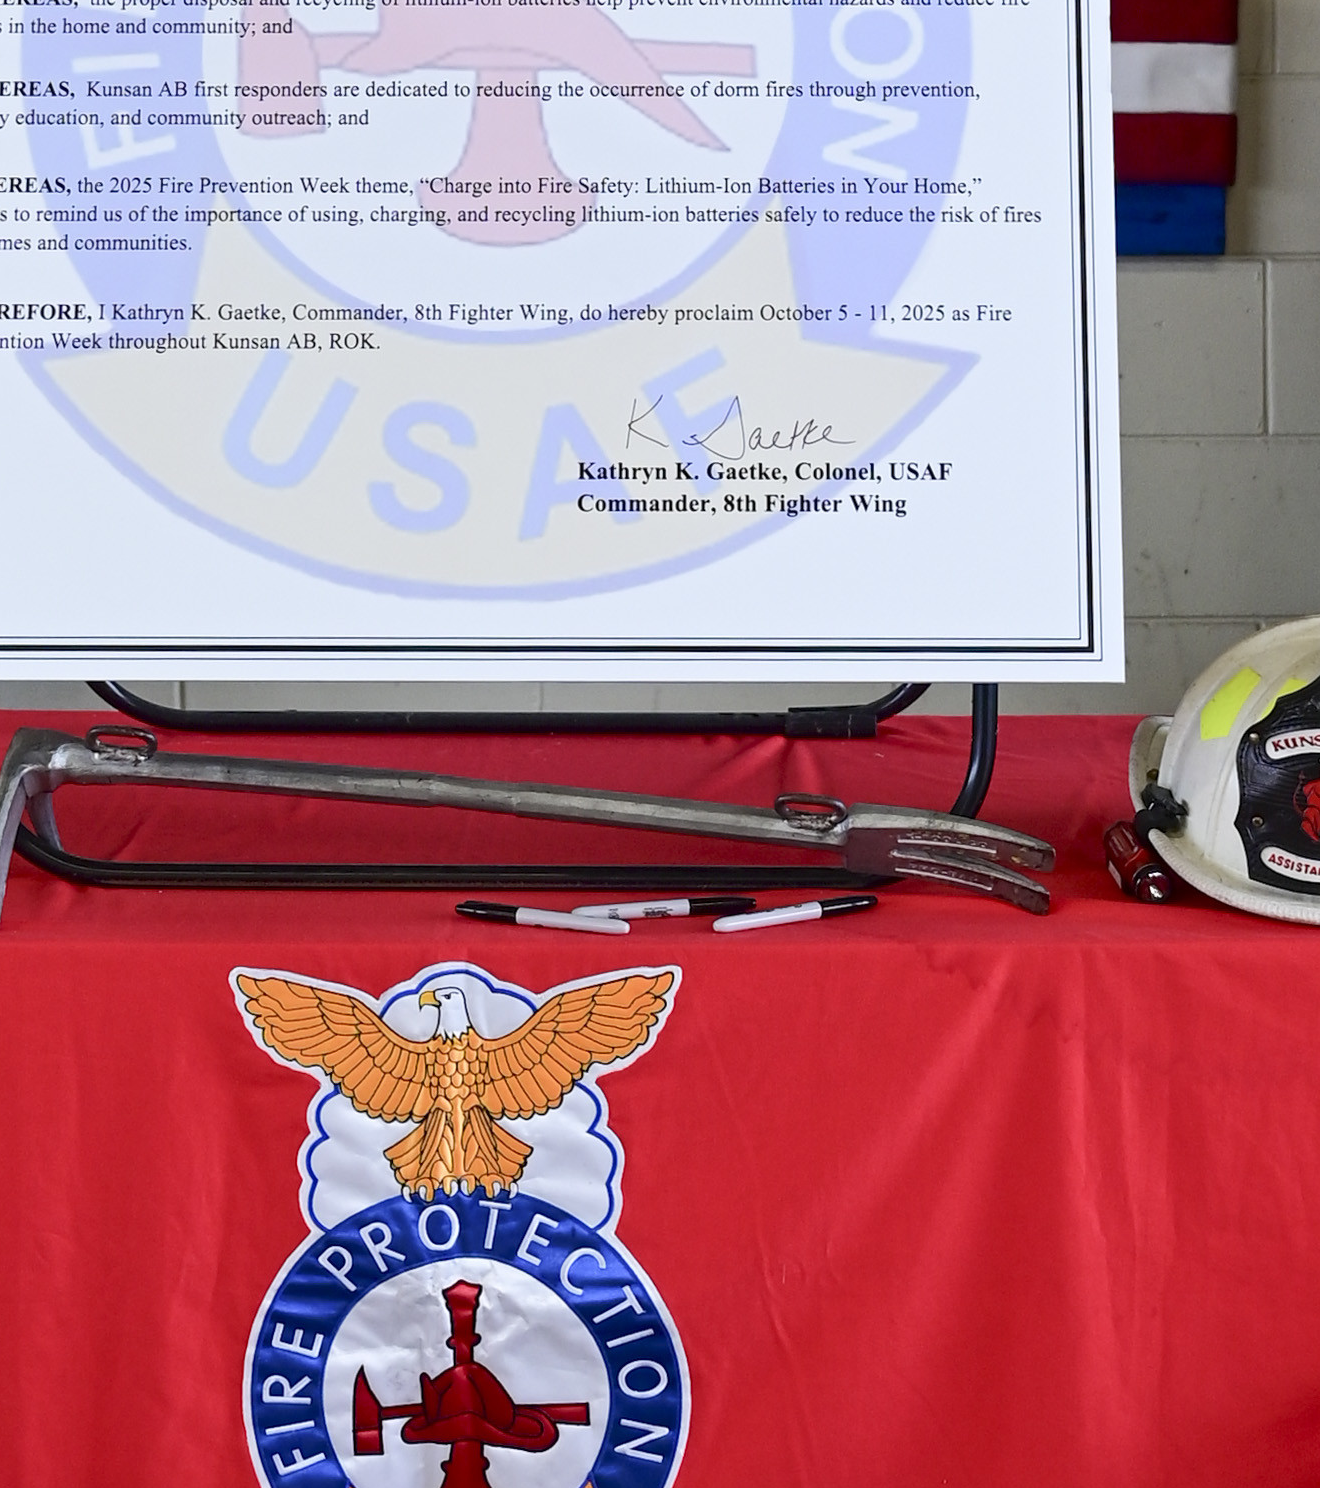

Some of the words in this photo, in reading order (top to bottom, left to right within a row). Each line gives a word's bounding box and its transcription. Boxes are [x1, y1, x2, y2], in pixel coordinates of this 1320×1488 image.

[8, 17, 25, 34] in
[30, 17, 57, 35] the
[62, 17, 111, 35] home
[115, 17, 147, 35] and
[152, 17, 256, 39] community;
[261, 16, 293, 35] and
[14, 108, 105, 129] education,
[110, 108, 142, 126] and
[147, 108, 247, 130] community
[251, 108, 332, 133] outreach;
[337, 108, 369, 126] and
[51, 332, 103, 350] Week
[108, 331, 207, 355] throughout
[212, 332, 280, 350] Kunsan
[286, 332, 323, 353] AB,
[329, 332, 381, 350] ROK.
[222, 343, 753, 543] USAF
[578, 461, 668, 486] Kathryn
[674, 461, 700, 481] K.
[706, 461, 788, 485] Gaetke,
[794, 461, 882, 485] Colonel,
[888, 461, 953, 482] USAF
[577, 493, 717, 517] Commander,
[723, 493, 757, 513] 8th
[764, 493, 843, 518] Fighter
[849, 493, 908, 518] Wing
[317, 1200, 669, 1466] PROTECTION
[263, 1321, 326, 1478] FIRE
